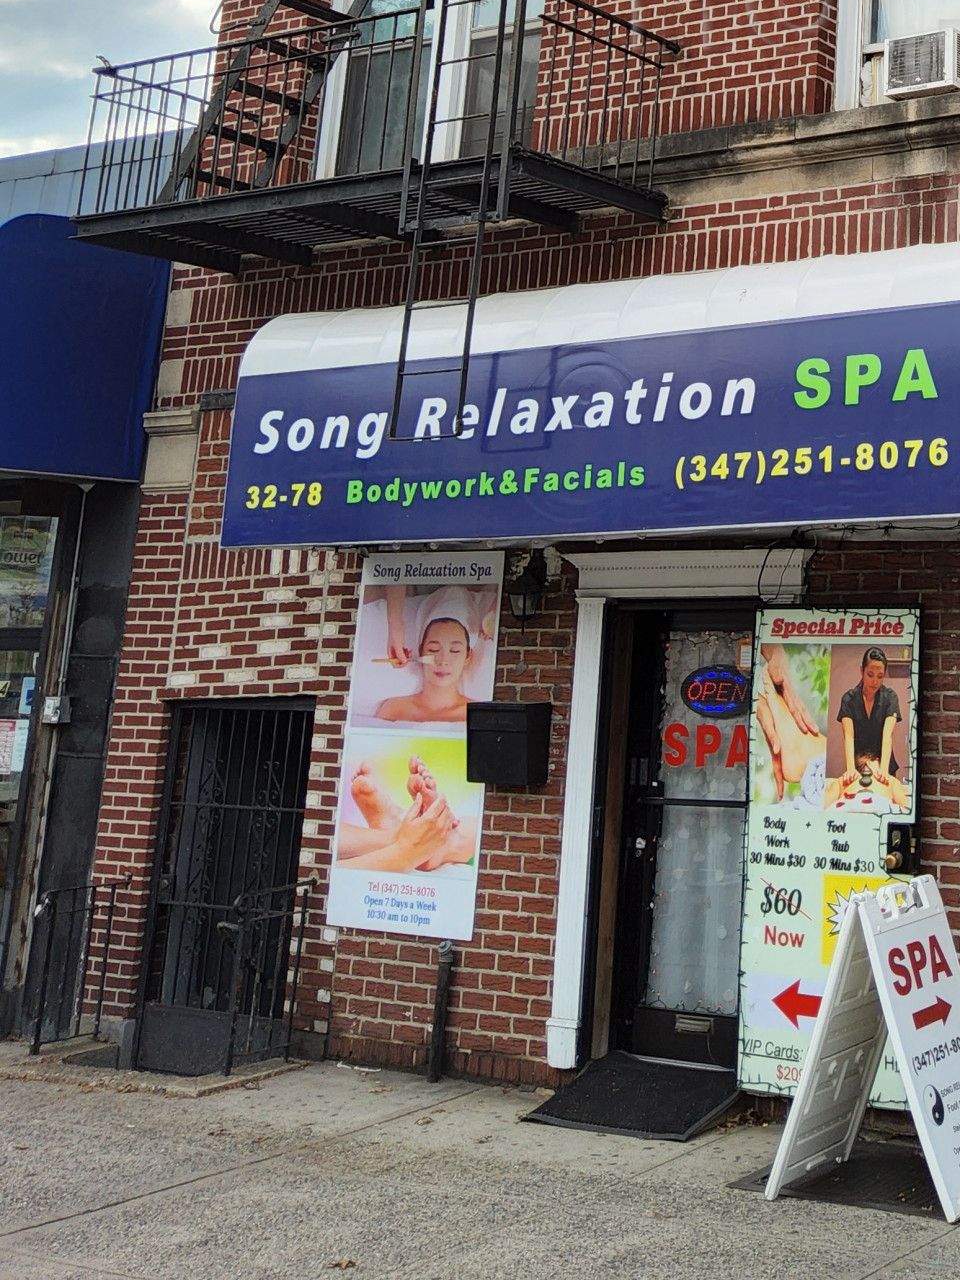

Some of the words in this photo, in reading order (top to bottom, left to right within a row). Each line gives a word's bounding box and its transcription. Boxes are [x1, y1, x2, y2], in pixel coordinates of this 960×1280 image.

[255, 406, 387, 459] Song
[413, 373, 756, 441] Relaxation
[794, 349, 938, 410] SPA
[246, 482, 322, 510] 32-78
[346, 461, 646, 505] Bodywork&Facials
[675, 437, 949, 492] (347)251-8076
[373, 564, 401, 581] Song
[404, 563, 466, 577] Relaxation
[469, 563, 491, 580] Spa
[771, 618, 845, 638] Special
[850, 618, 905, 635] Price
[688, 681, 748, 702] OPEN
[664, 723, 748, 768] SPA
[764, 816, 786, 833] Body
[765, 834, 790, 848] Work
[750, 852, 762, 864] 30
[764, 853, 785, 866] Mins
[787, 853, 806, 868] $30
[813, 857, 826, 869] 30
[829, 858, 851, 871] Mins
[853, 859, 875, 874] $30
[368, 882, 380, 892] Tel
[381, 883, 399, 895] (347)
[401, 886, 436, 898] 251-8076
[761, 883, 802, 917] $60
[364, 896, 384, 907] Open
[385, 897, 390, 907] 7
[391, 898, 408, 910] Days
[416, 900, 438, 912] Week
[387, 914, 399, 922] am
[400, 913, 408, 923] to
[410, 914, 430, 926] 10pm
[764, 925, 805, 948] Now
[888, 935, 953, 996] SPA
[765, 1041, 804, 1060] Cards:
[940, 1084, 953, 1097] SONG
